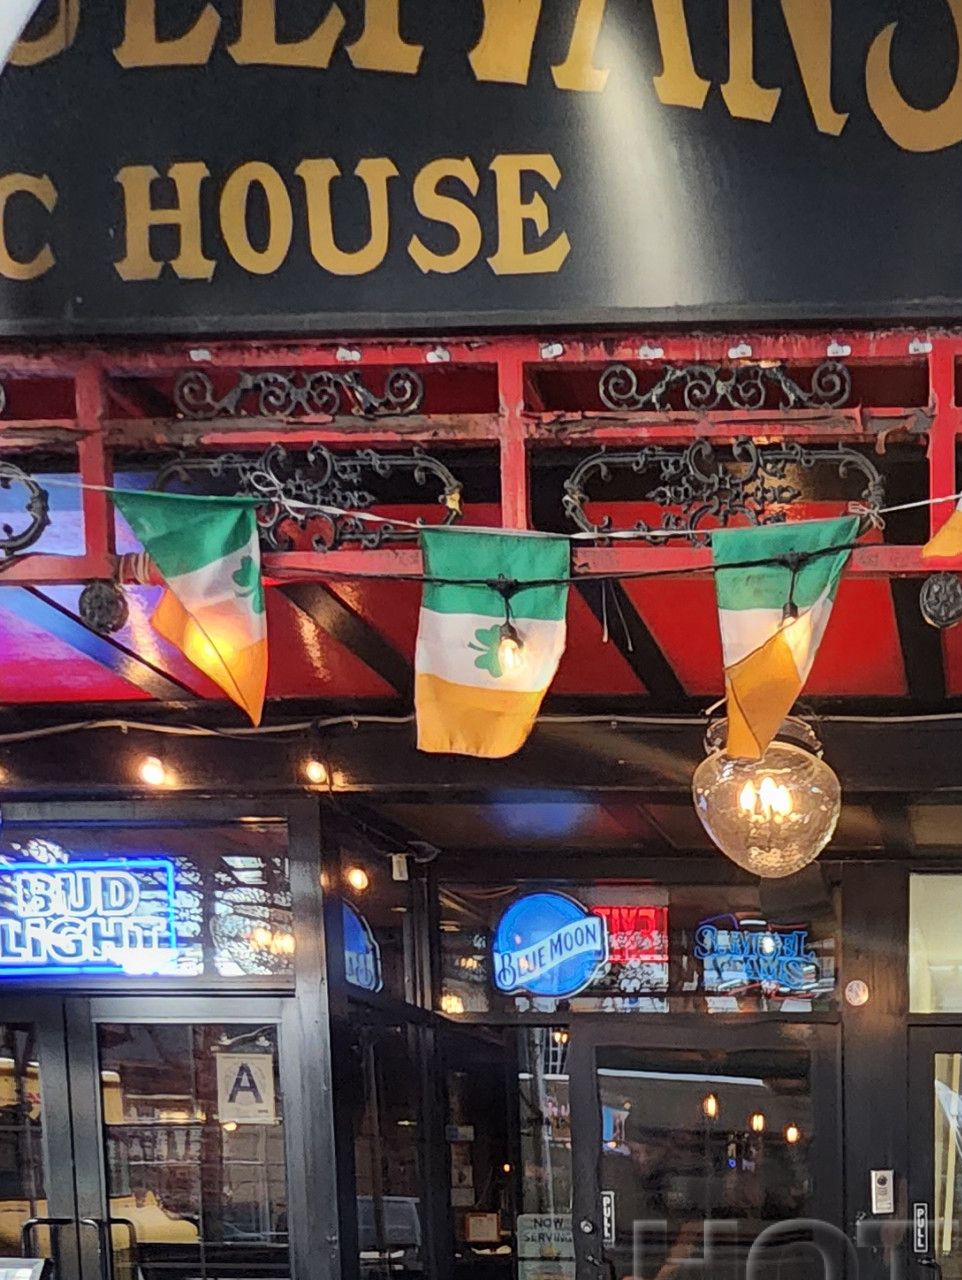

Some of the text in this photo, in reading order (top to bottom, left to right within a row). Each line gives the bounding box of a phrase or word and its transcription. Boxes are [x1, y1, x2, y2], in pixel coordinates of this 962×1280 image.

[114, 153, 571, 282] HOUSE
[16, 871, 141, 918] BUD
[0, 916, 168, 964] LIGHT
[498, 924, 596, 987] BLUE MOON
[227, 1063, 264, 1104] A
[533, 1218, 565, 1230] NOW
[917, 1208, 925, 1247] PULL
